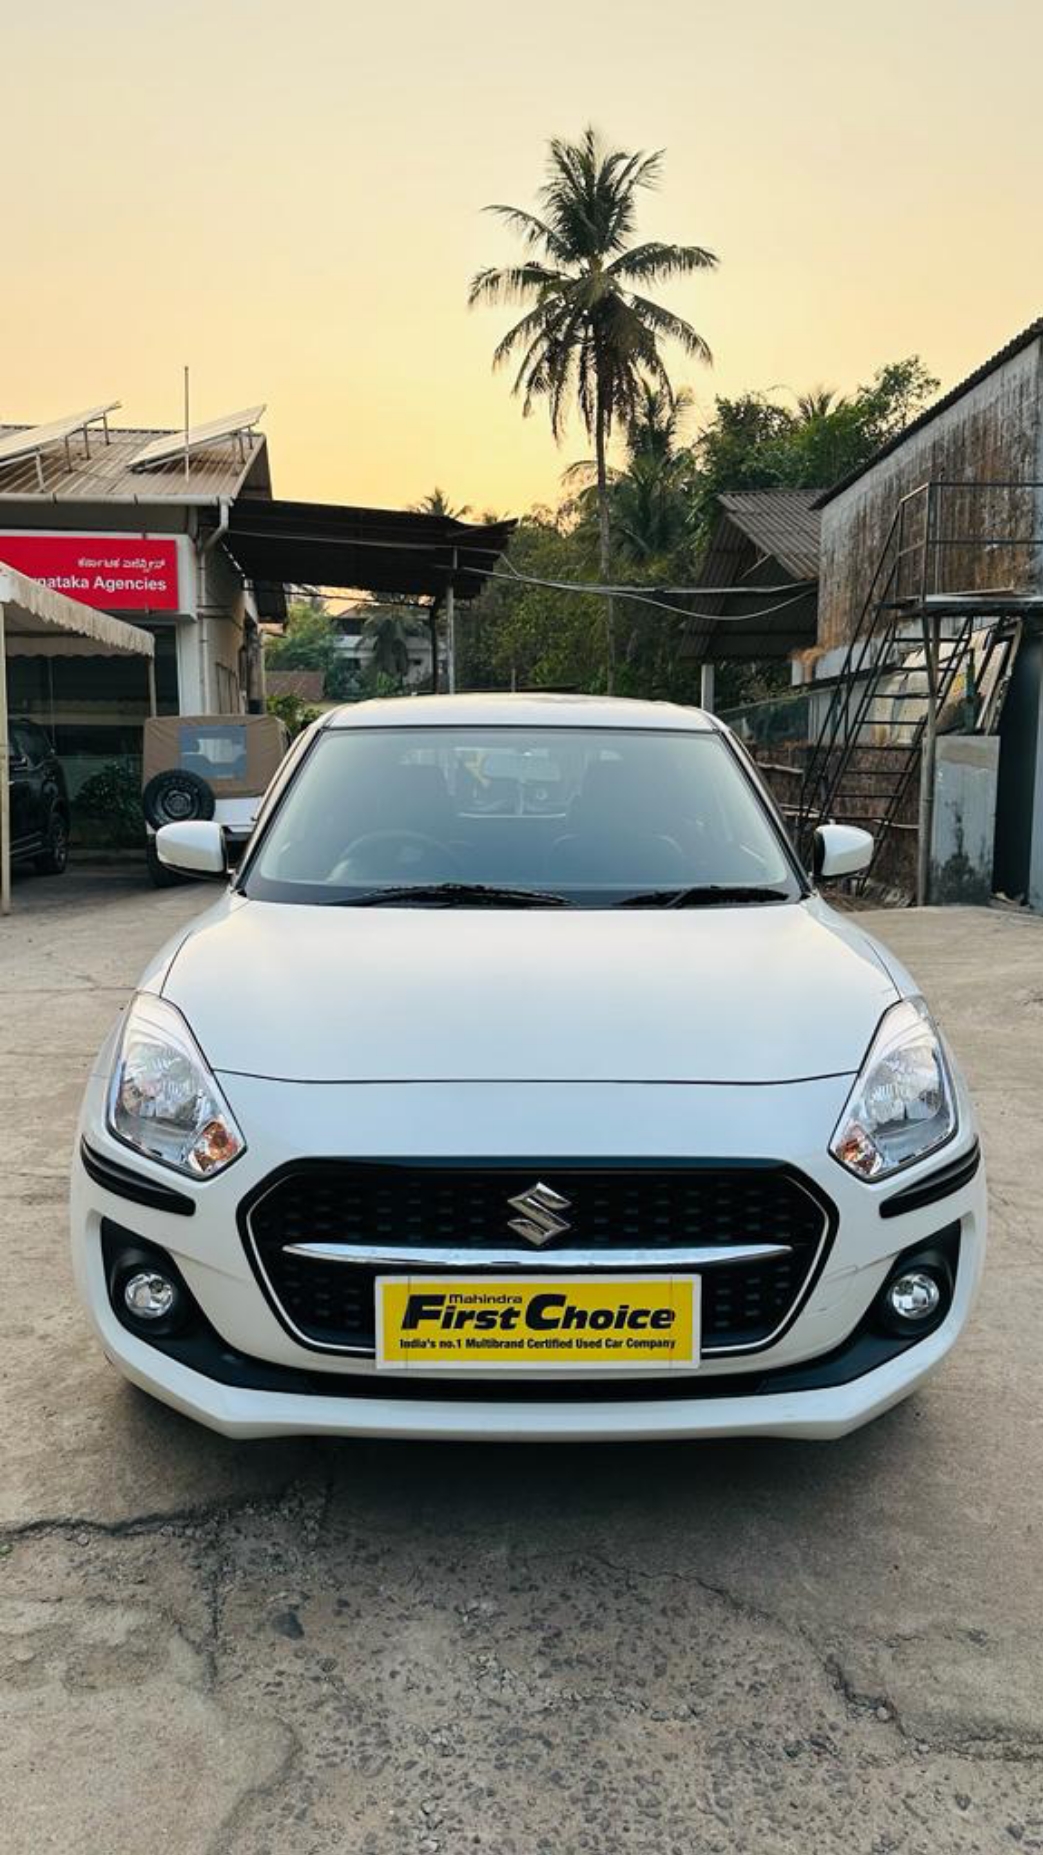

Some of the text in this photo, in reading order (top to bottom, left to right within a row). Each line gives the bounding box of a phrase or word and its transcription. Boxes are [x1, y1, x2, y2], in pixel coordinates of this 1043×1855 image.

[33, 575, 167, 592] nataka Agencies
[449, 1294, 522, 1304] Mahindra
[401, 1293, 676, 1331] First Choice
[400, 1338, 676, 1351] India's no.1 Multibrand Certified Used Car Company
